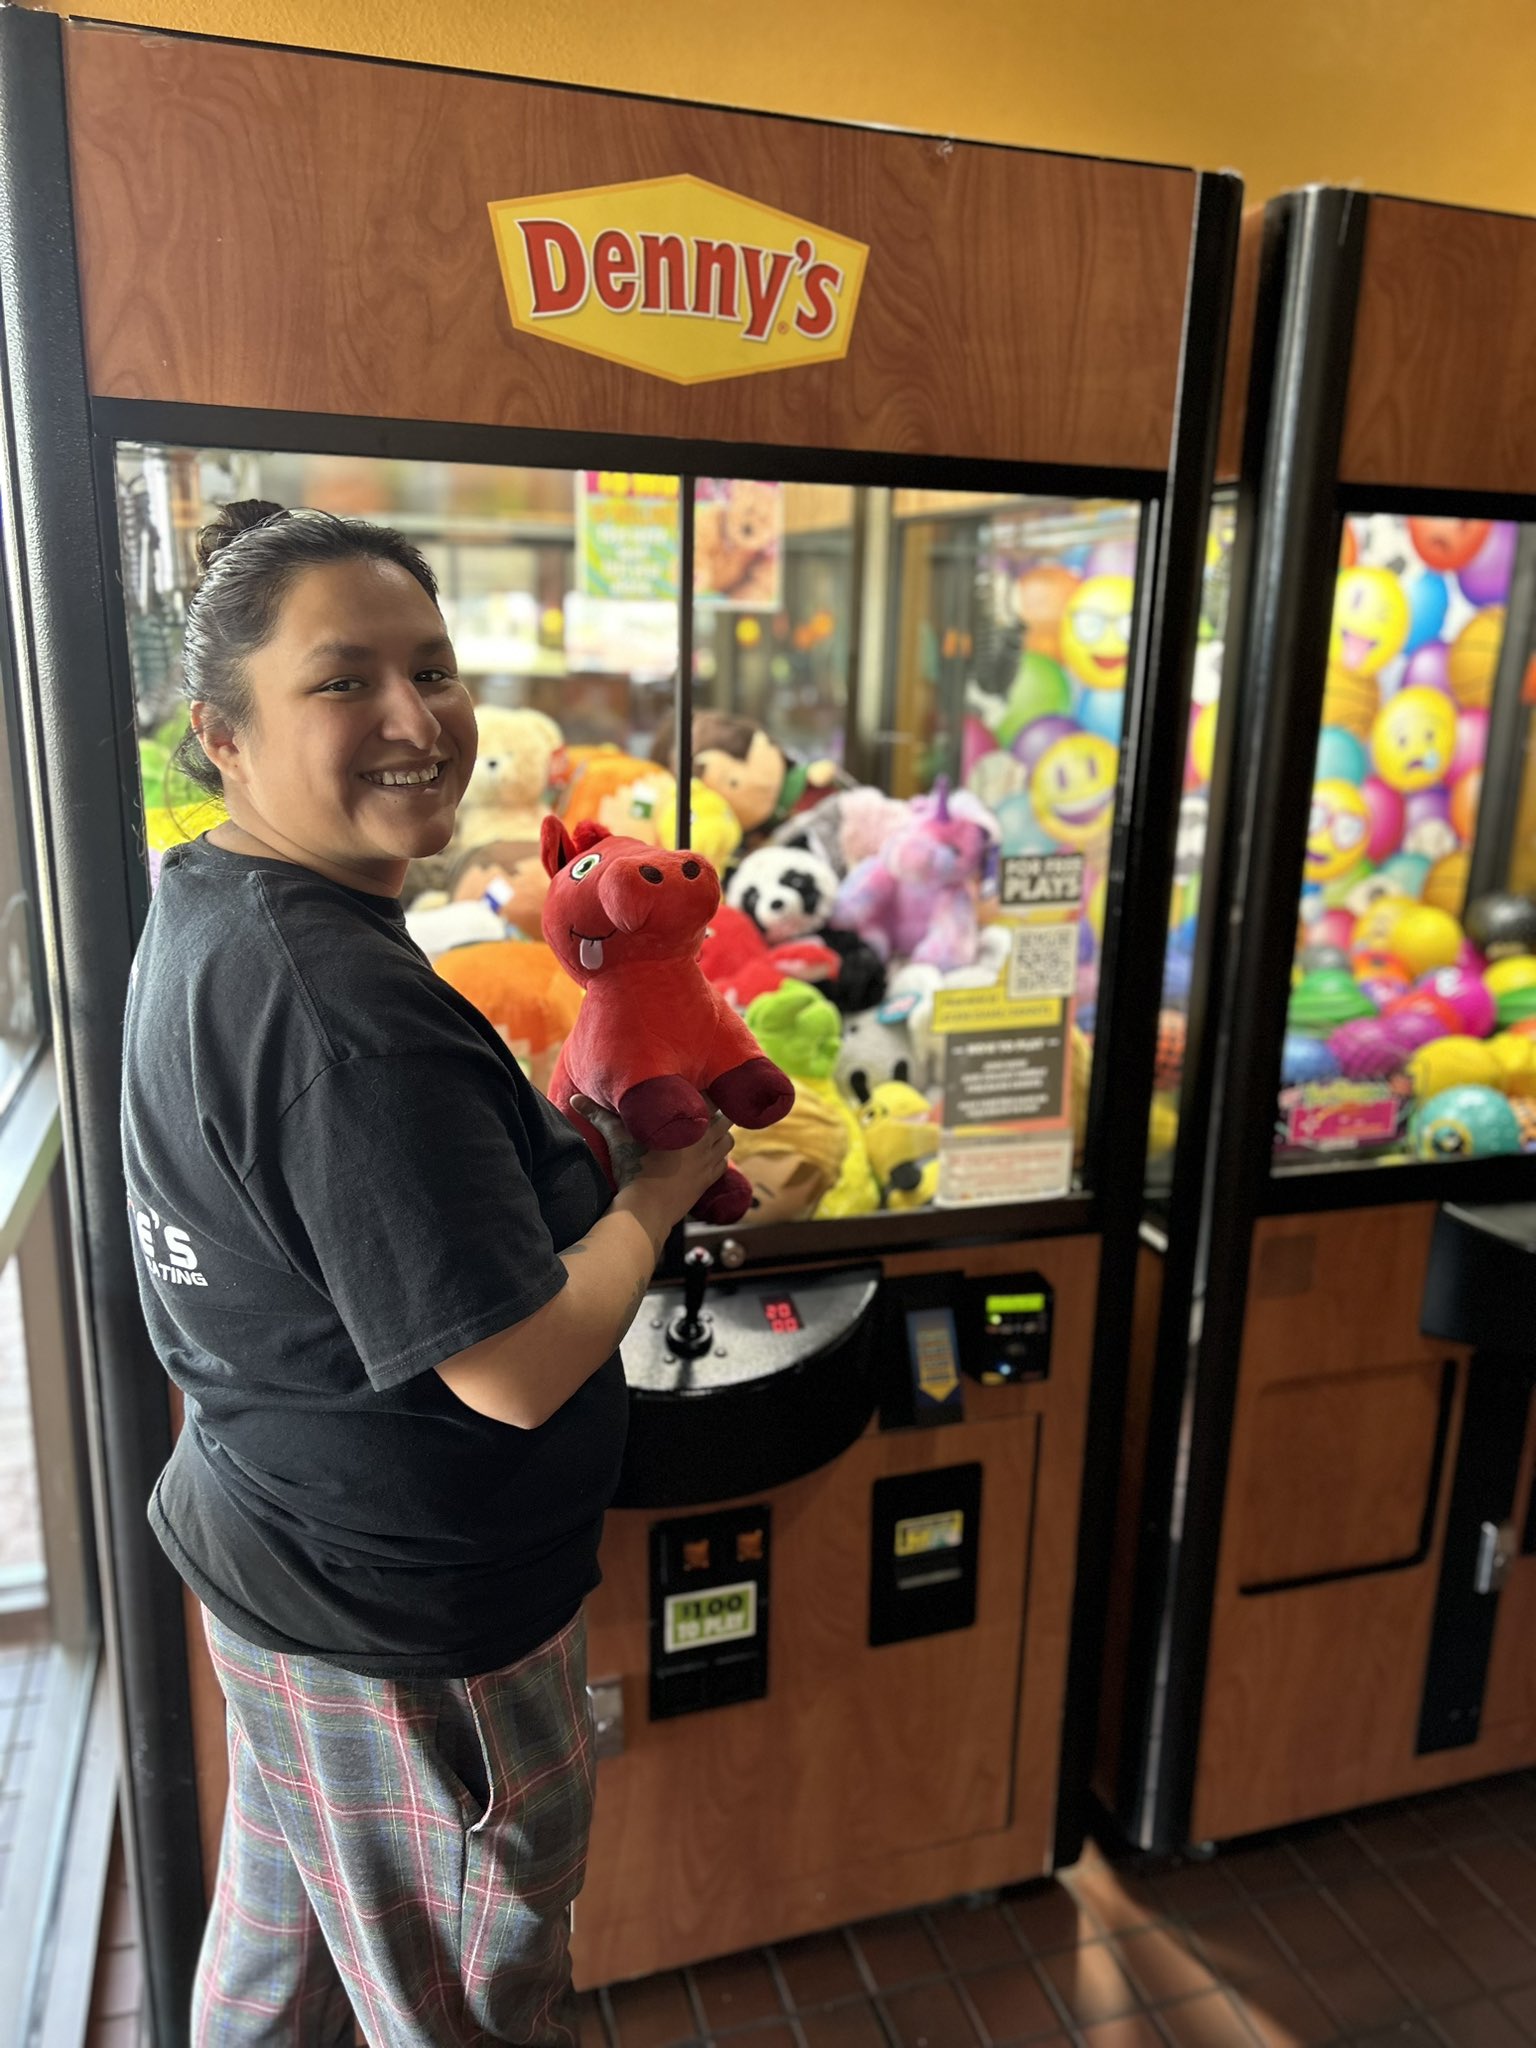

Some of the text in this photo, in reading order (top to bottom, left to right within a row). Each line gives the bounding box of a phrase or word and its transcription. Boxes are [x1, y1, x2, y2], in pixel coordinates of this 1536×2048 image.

[515, 218, 843, 342] Denny's
[1004, 876, 1080, 902] PLAYS
[704, 1615, 744, 1637] PLAY
